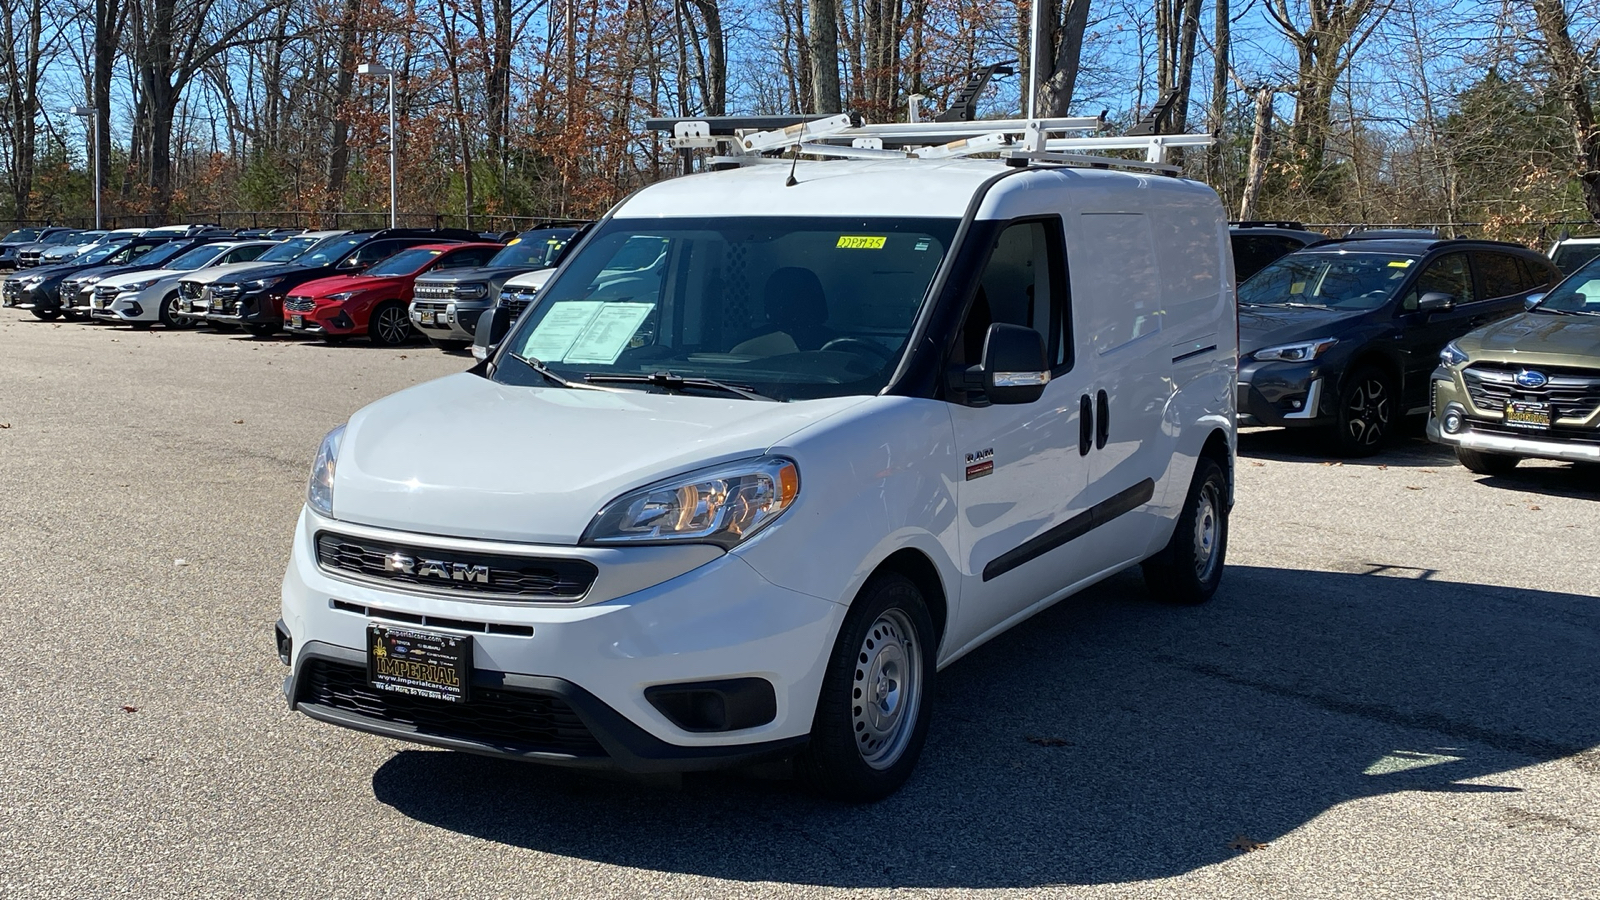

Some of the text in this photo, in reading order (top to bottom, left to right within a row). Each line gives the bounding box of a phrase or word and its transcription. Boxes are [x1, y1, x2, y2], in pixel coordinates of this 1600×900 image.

[965, 447, 994, 464] RAM
[384, 553, 489, 583] RAM
[377, 657, 460, 686] IMPERIAL
[377, 674, 460, 693] www.imperialcars.com
[442, 693, 456, 702] More
